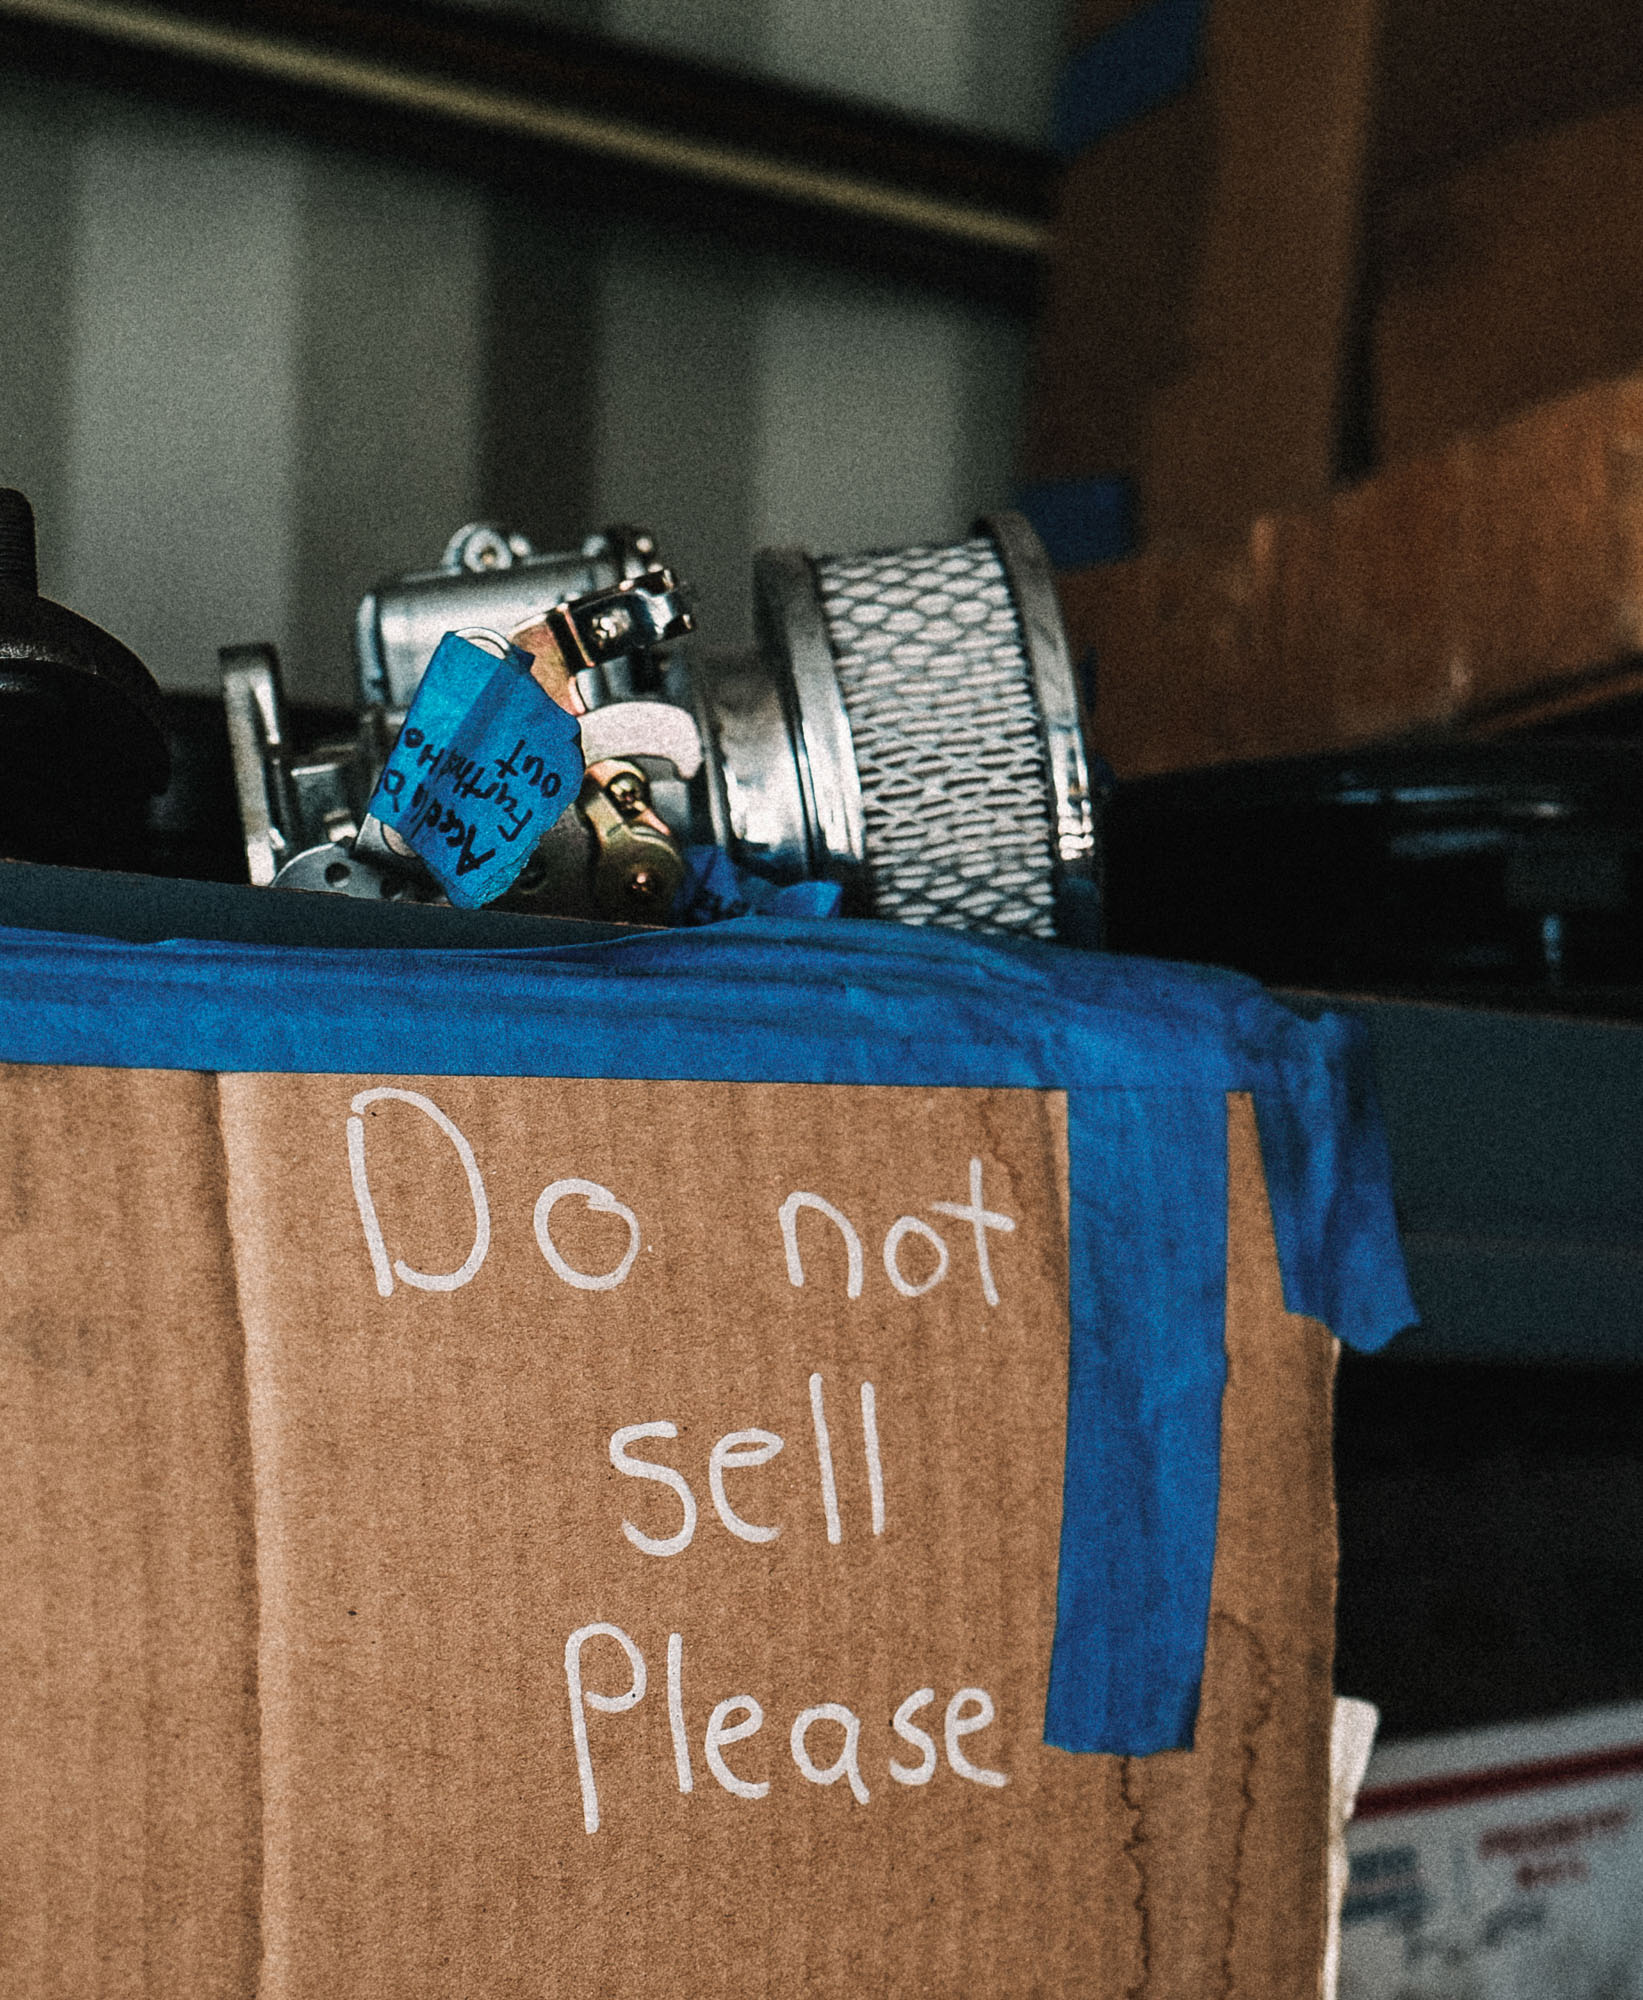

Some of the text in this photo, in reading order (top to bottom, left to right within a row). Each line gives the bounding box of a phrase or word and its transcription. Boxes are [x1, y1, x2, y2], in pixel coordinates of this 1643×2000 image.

[346, 1085, 1016, 1306] Do not
[609, 1373, 885, 1557] sell
